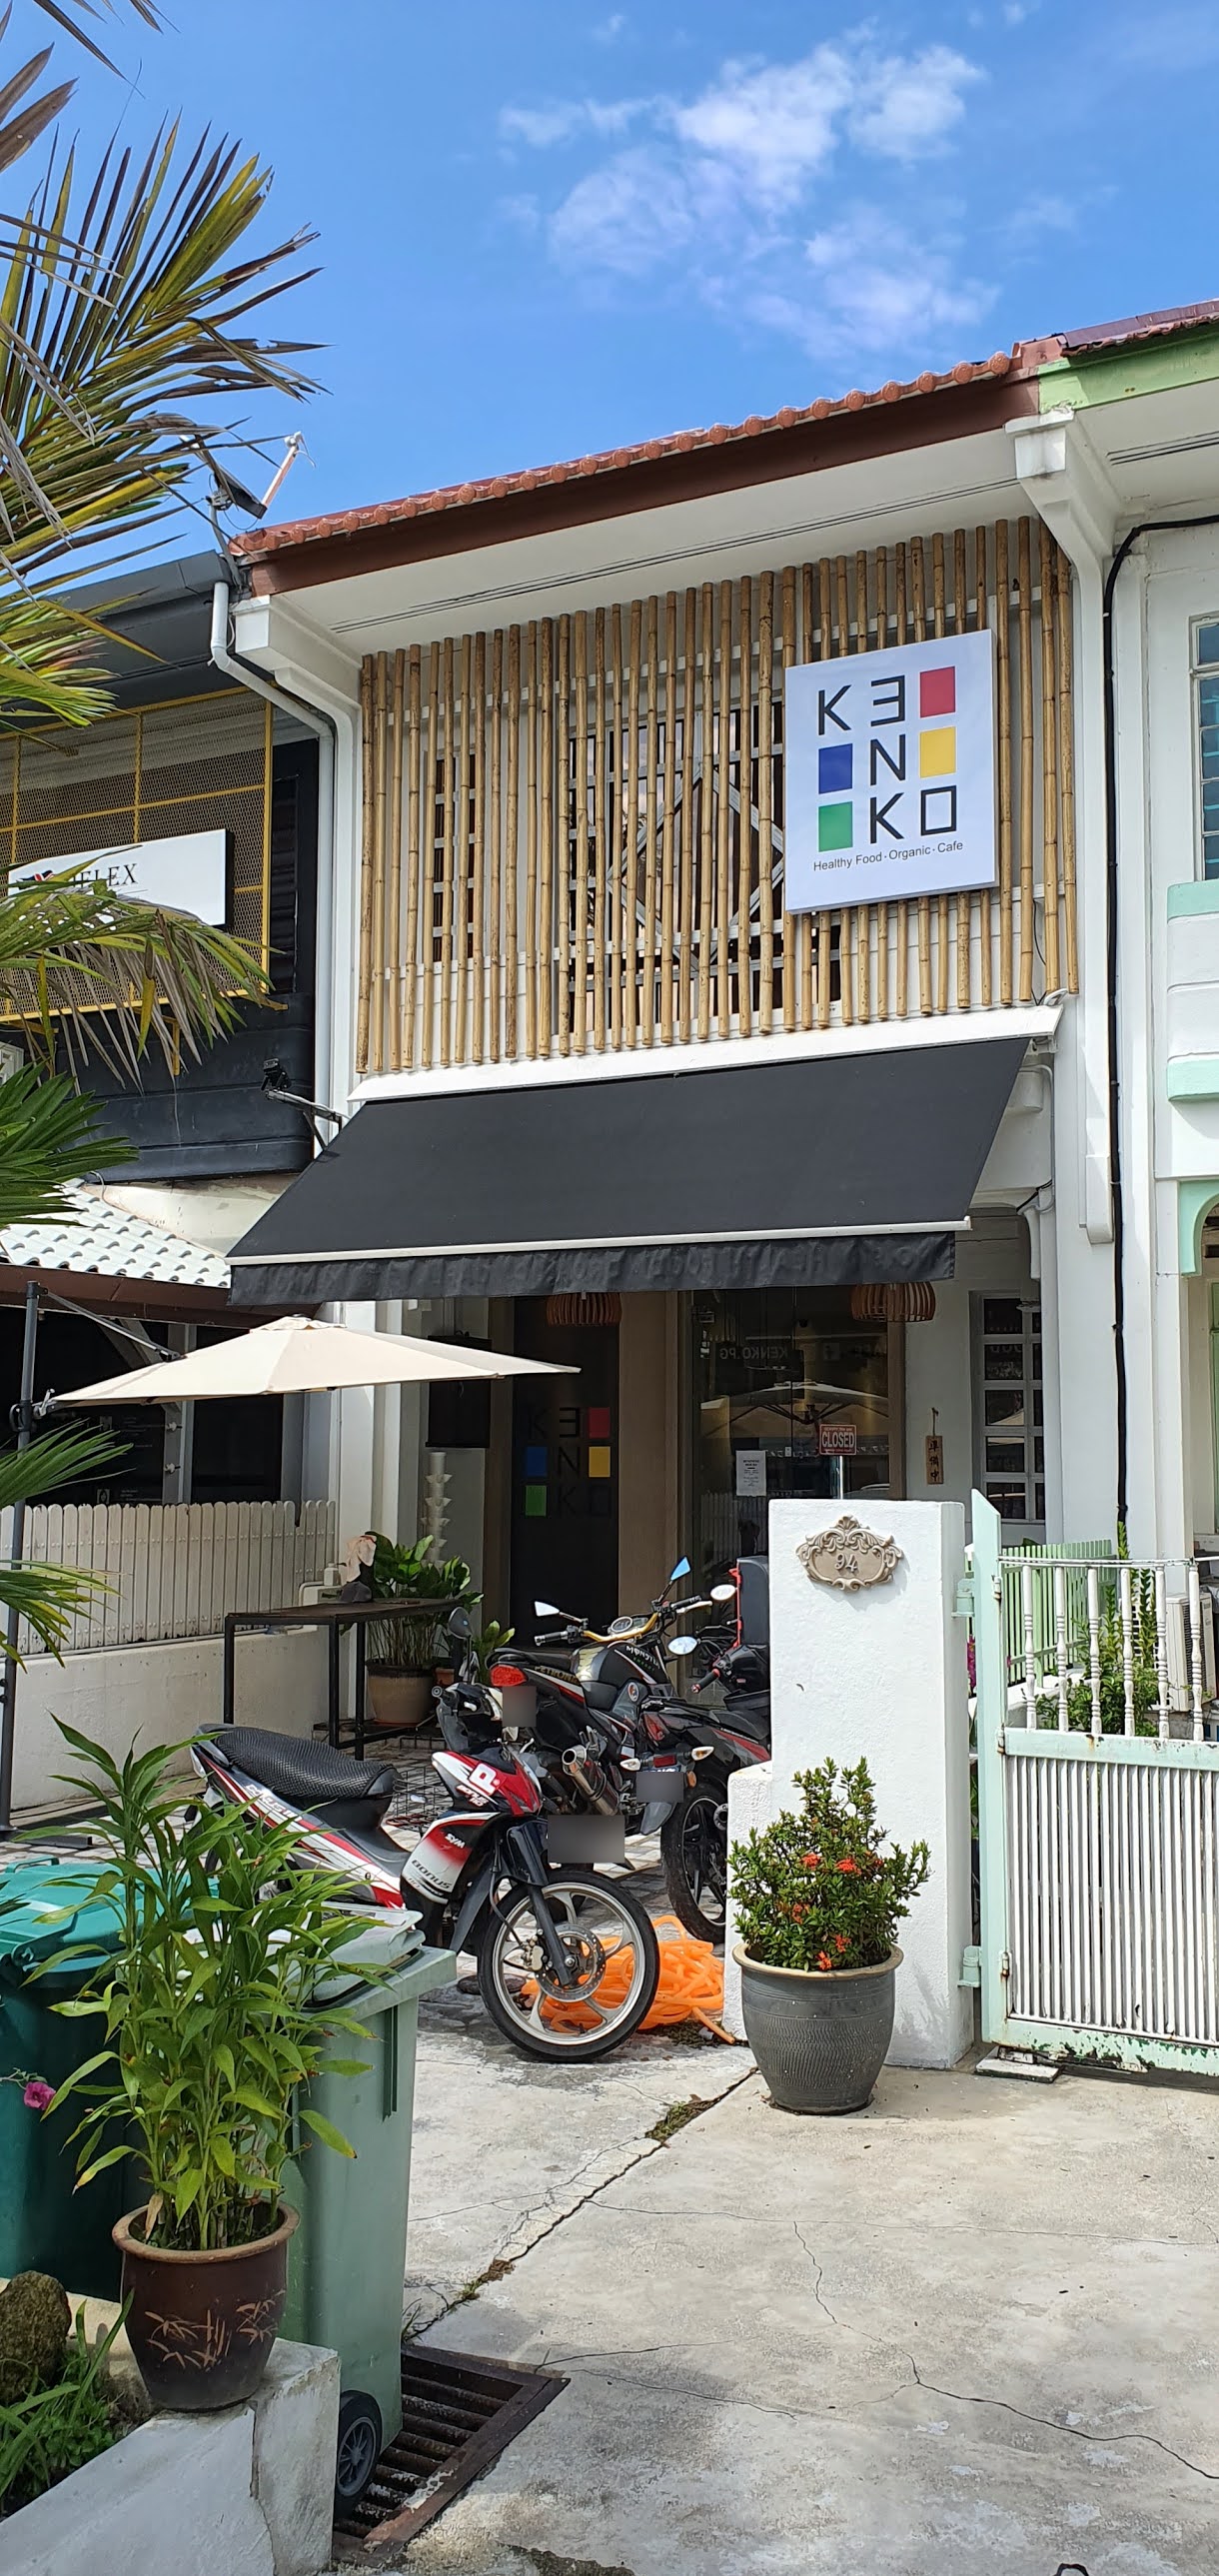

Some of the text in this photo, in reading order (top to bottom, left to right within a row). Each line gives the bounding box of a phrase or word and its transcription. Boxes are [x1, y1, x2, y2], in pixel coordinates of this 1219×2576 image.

[813, 840, 963, 871] Healthy Food Organic Cafe
[822, 1431, 855, 1448] CLOSED
[834, 1554, 858, 1573] 94
[445, 1834, 466, 1849] SYM
